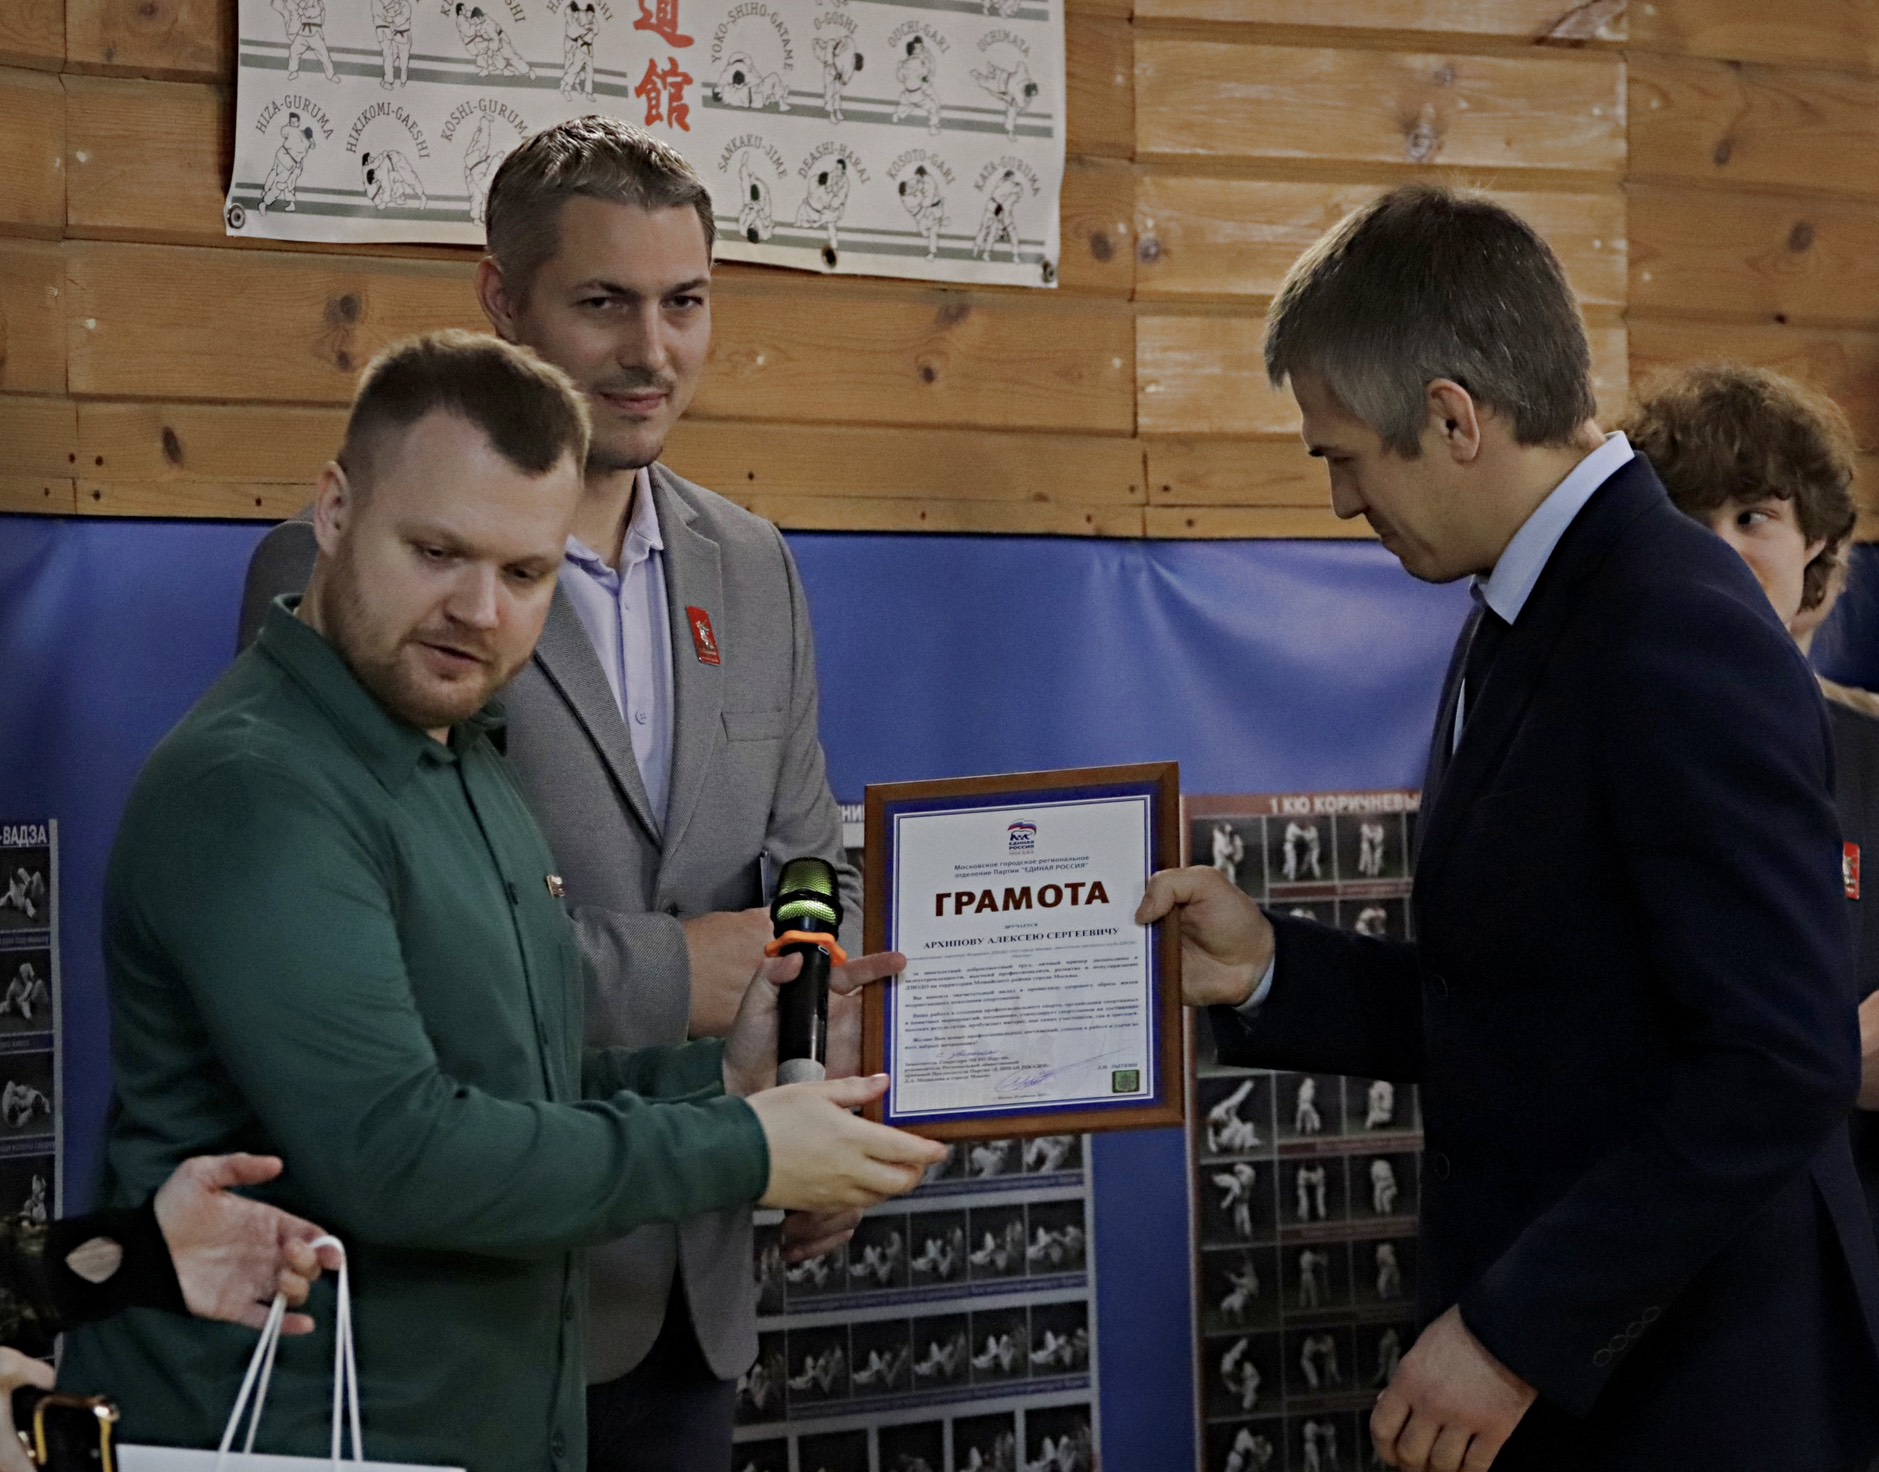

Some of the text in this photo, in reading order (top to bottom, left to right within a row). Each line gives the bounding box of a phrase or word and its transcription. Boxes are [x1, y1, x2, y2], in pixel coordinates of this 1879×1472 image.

[711, 1, 794, 71] YOKO-SHIHO-GATAME
[813, 11, 859, 35] O-GOSHI
[887, 20, 951, 54] OUCHI-GARI
[977, 29, 1031, 58] UCHIMATA
[255, 94, 334, 140] HIZA-GURUMA
[346, 102, 430, 160] HIKIKOMI-GAESHI
[717, 134, 788, 180] SANKAKU-JIME
[798, 141, 871, 184] DEASHI-HARAI
[886, 149, 957, 185] KOSOTO-GARI
[973, 156, 1041, 196] KATA-GURUMA
[1271, 797, 1279, 814] 1
[954, 855, 1089, 870] Московское городское региональное
[955, 870, 992, 878] отделение
[993, 868, 1020, 876] Партии
[935, 880, 1110, 917] ГРАМОТА
[988, 933, 1044, 944] АЛЕКСЕЮ
[1046, 927, 1120, 940] СЕРГЕЕВИЧУ
